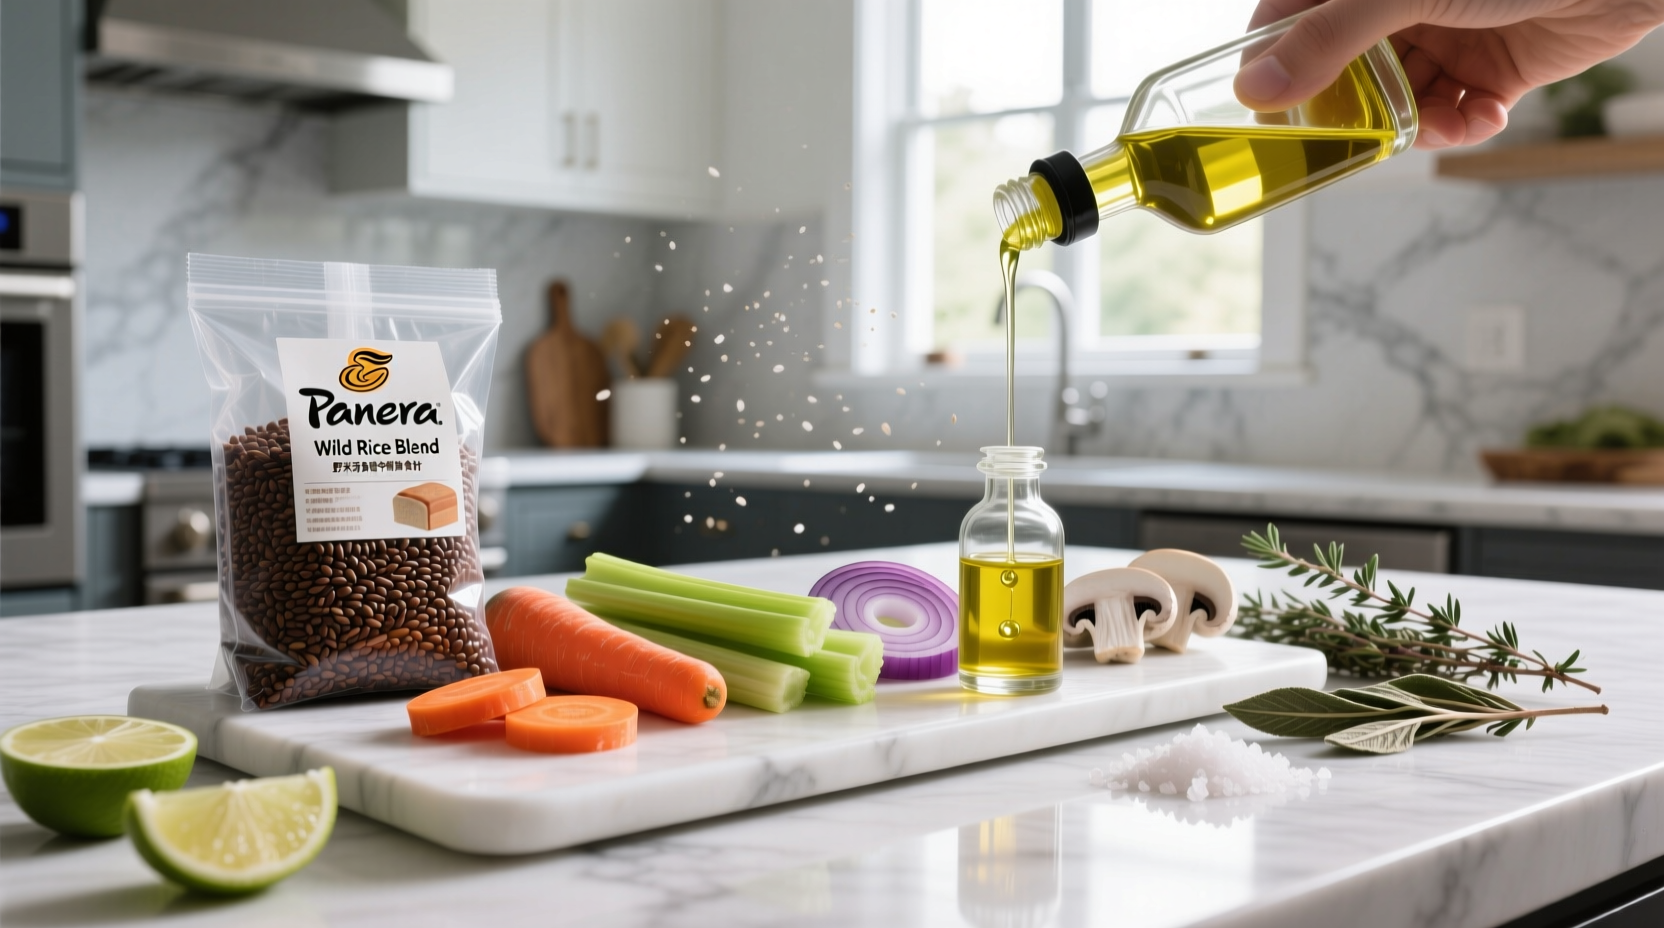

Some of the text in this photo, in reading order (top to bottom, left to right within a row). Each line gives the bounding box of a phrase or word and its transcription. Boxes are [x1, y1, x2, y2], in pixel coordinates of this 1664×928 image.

[314, 437, 440, 456] Wild Rice Blend
